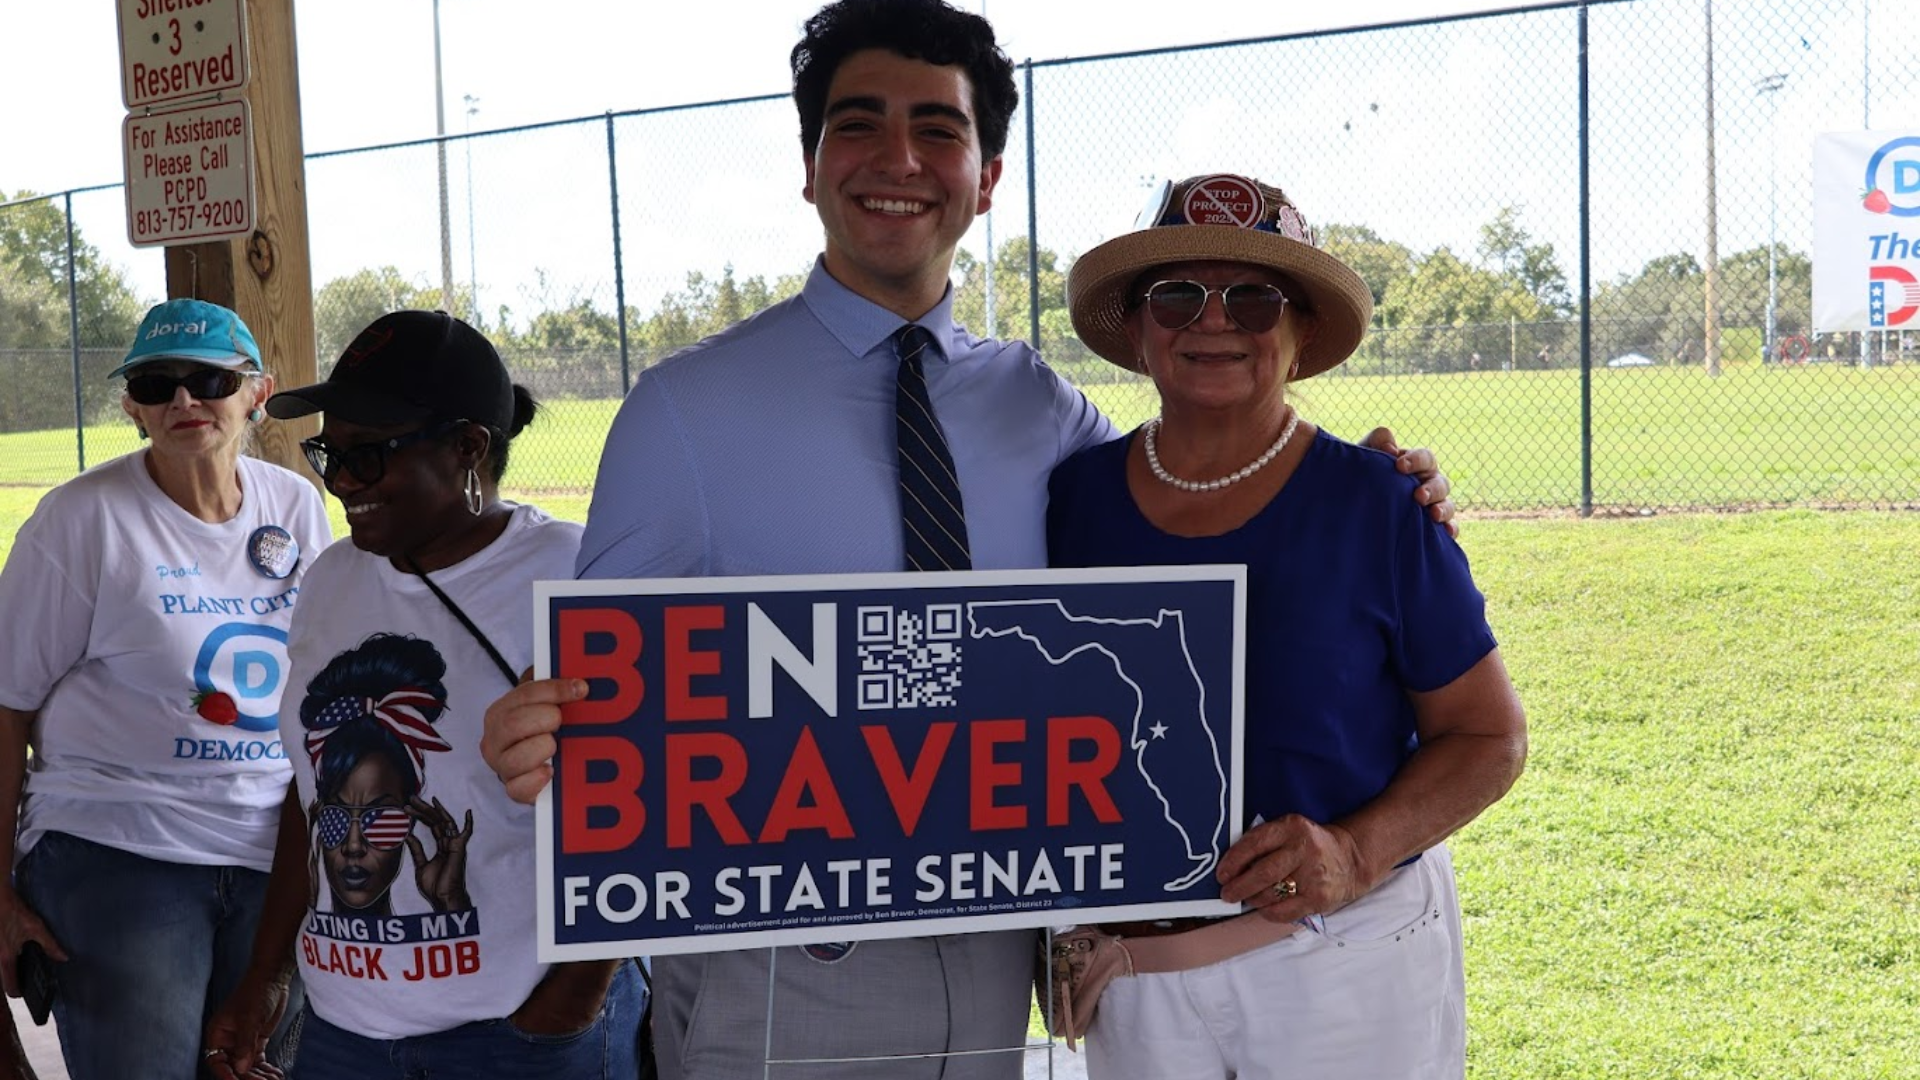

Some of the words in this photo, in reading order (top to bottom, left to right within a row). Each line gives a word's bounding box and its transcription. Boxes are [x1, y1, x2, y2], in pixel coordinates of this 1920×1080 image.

[168, 18, 182, 56] 3
[133, 45, 235, 99] Reserved
[132, 125, 156, 150] For
[165, 116, 242, 146] Assistance
[144, 153, 192, 178] Please
[201, 144, 228, 171] Call
[164, 177, 207, 205] PCPD
[1192, 201, 1251, 213] PROJECT
[1205, 189, 1240, 200] STOP
[137, 199, 244, 235] 813-757-9200
[1204, 214, 1235, 224] 2025
[145, 320, 207, 340] doral
[156, 562, 202, 578] Proud
[159, 594, 245, 615] PLANT
[558, 601, 838, 726] BEN
[560, 714, 1124, 855] BRAVER
[564, 869, 692, 927] FOR
[713, 857, 892, 916] STATE
[914, 843, 1124, 903] SENATE
[308, 913, 370, 941] OTING
[376, 918, 406, 942] IS
[420, 911, 472, 940] MY
[694, 922, 726, 931] Political
[726, 919, 781, 930] advertisement
[782, 917, 799, 927] paid
[800, 916, 811, 924] for
[812, 915, 826, 923] and
[828, 913, 863, 923] approved
[865, 913, 874, 921] by
[875, 911, 890, 919] Ben
[891, 909, 917, 918] Braver,
[956, 905, 968, 913] for
[968, 904, 987, 912] State
[1016, 899, 1043, 909] District
[302, 934, 389, 981] BLACK
[402, 940, 481, 981] JOB
